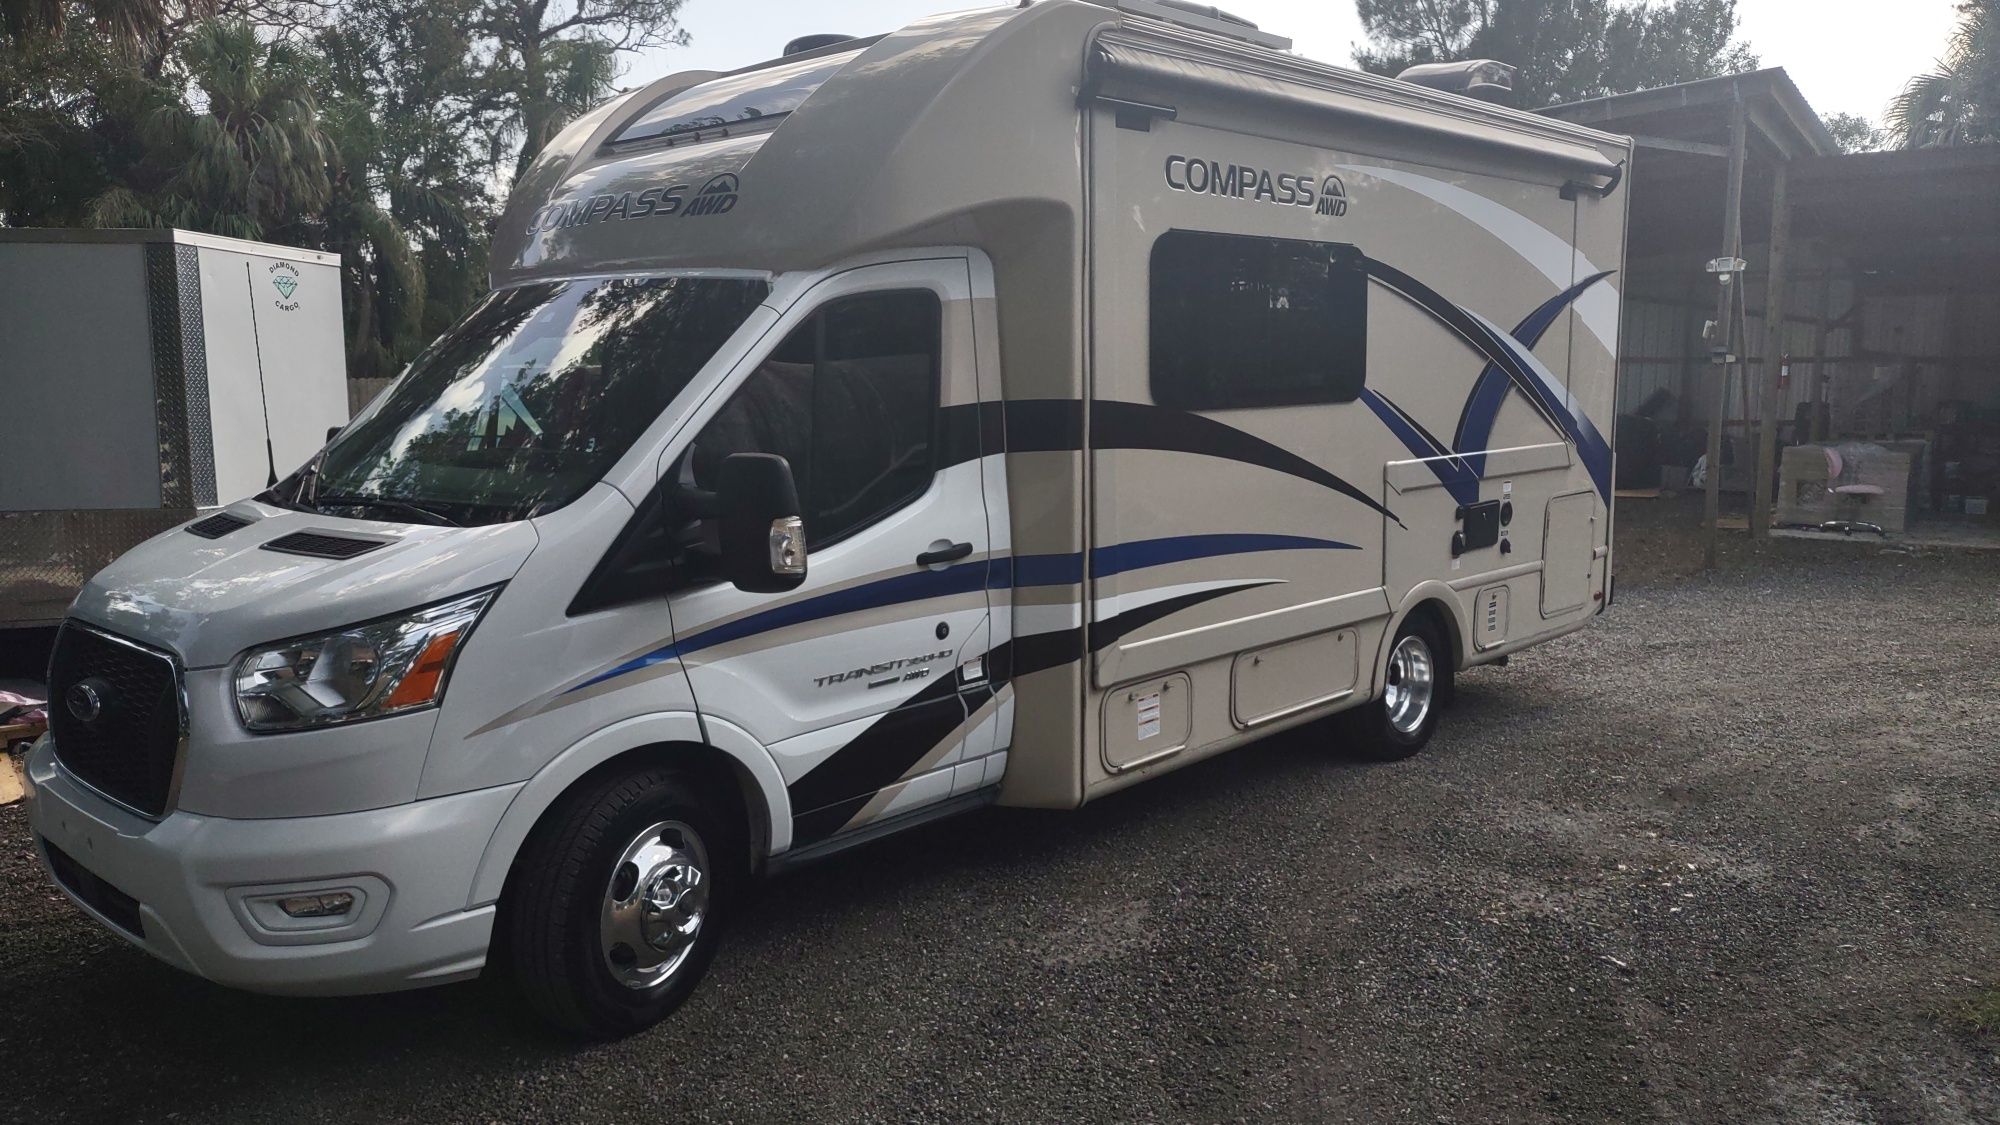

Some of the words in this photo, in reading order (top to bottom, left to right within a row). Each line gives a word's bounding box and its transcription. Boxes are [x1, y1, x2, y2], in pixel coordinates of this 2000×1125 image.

[1164, 154, 1315, 208] COMPASS
[1315, 197, 1348, 217] AWD
[525, 184, 690, 236] COMPASS
[680, 193, 739, 218] AWD
[269, 261, 299, 277] DIAMOND
[275, 300, 299, 311] CARGO
[902, 668, 930, 682] AWD
